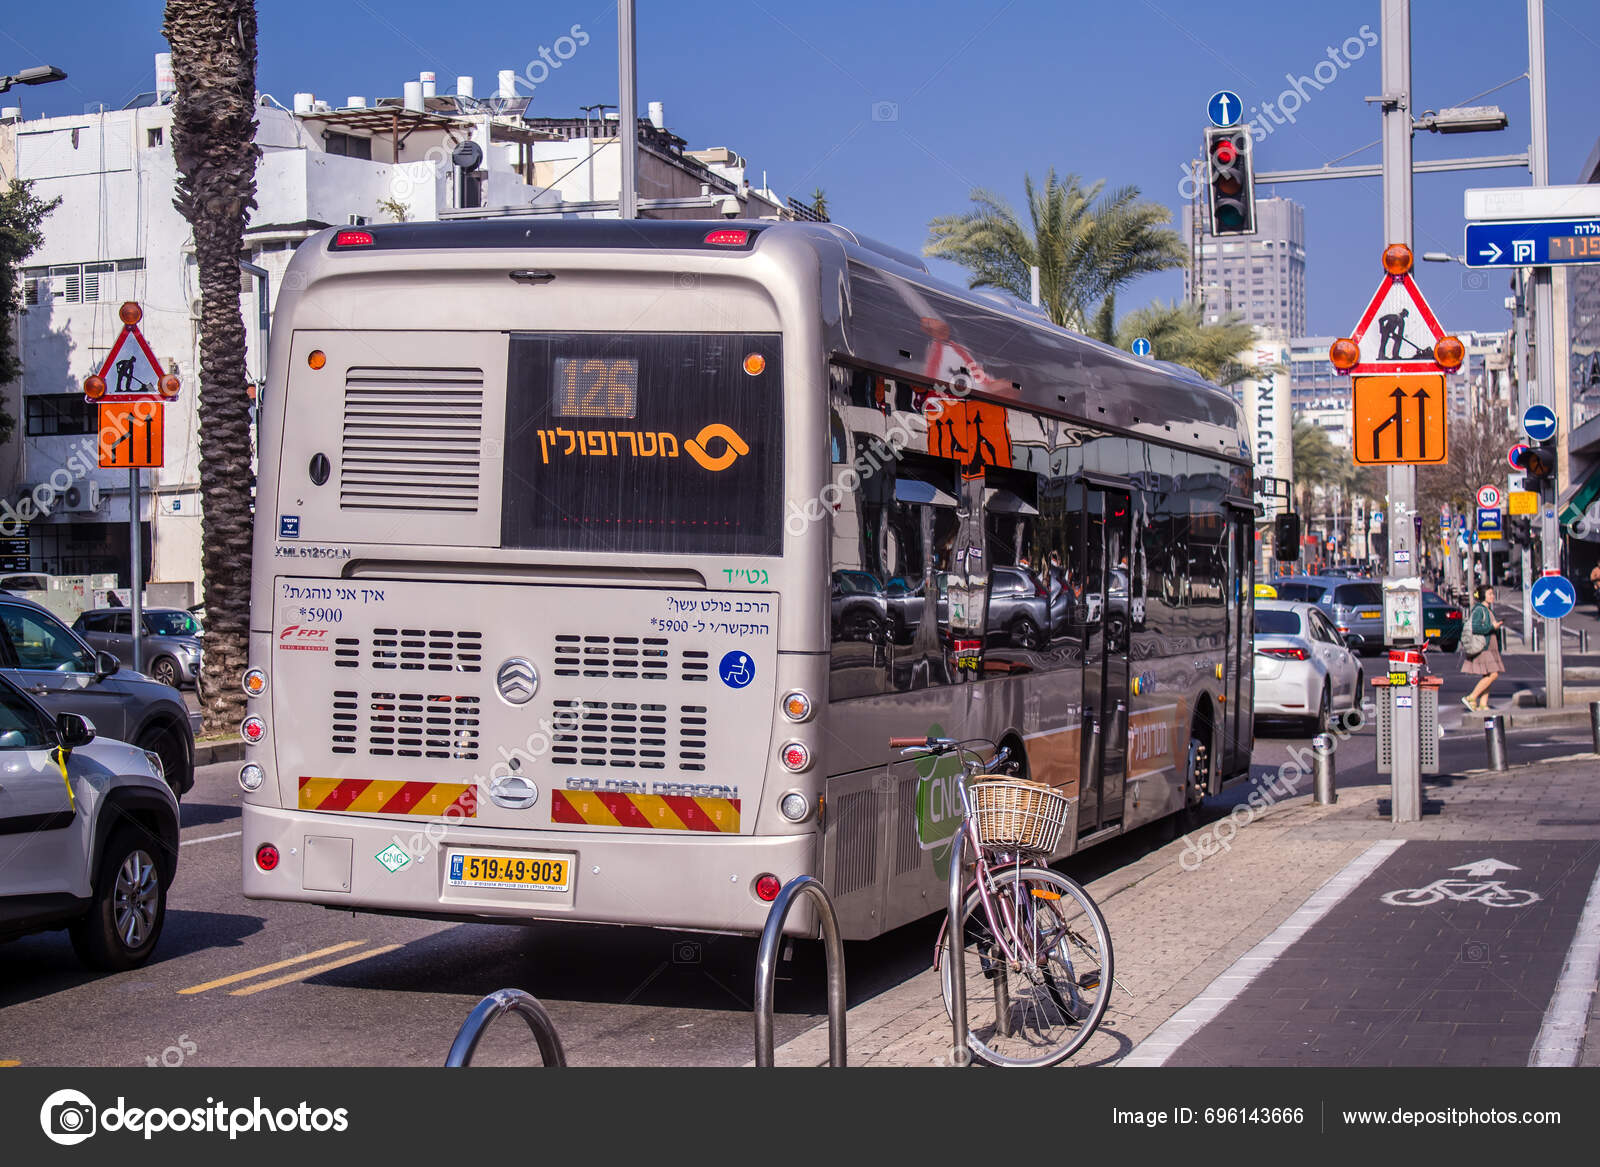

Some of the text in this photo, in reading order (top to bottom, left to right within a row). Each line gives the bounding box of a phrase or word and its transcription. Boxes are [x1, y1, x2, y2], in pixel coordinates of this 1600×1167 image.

[562, 360, 634, 416] 126
[537, 427, 679, 464] מטרופולין
[1482, 491, 1496, 503] 30
[336, 587, 357, 600] אני
[361, 590, 385, 604] איך
[701, 599, 732, 613] פולט
[735, 601, 770, 613] הרכב
[297, 629, 329, 638] FPT
[710, 622, 769, 637] התקשר/י
[566, 776, 738, 799] GOLDEN DRAGON
[930, 774, 962, 823] CNG
[382, 852, 403, 864] CNG
